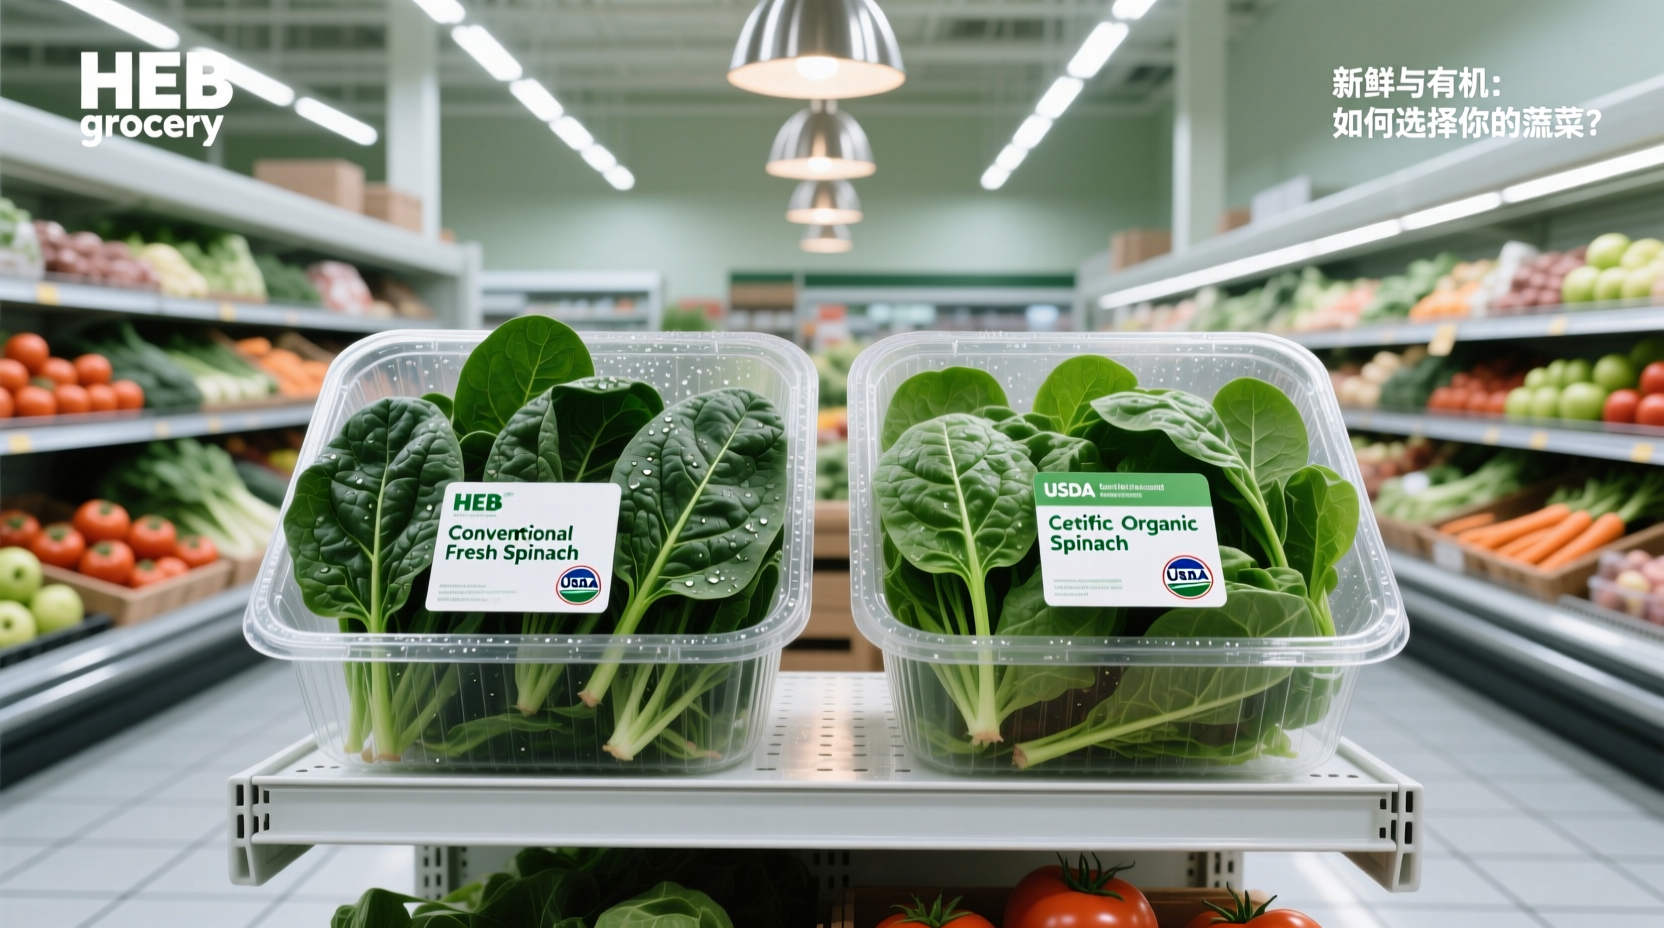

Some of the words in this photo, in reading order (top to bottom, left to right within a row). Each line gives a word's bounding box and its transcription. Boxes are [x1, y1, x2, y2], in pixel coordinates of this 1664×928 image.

[1043, 482, 1096, 498] USDA
[453, 493, 503, 511] HEB
[448, 524, 574, 541] Conventional
[1121, 514, 1199, 536] Organic
[1050, 534, 1129, 555] Spinach
[445, 544, 498, 561] Fresh
[503, 544, 579, 565] Spinach
